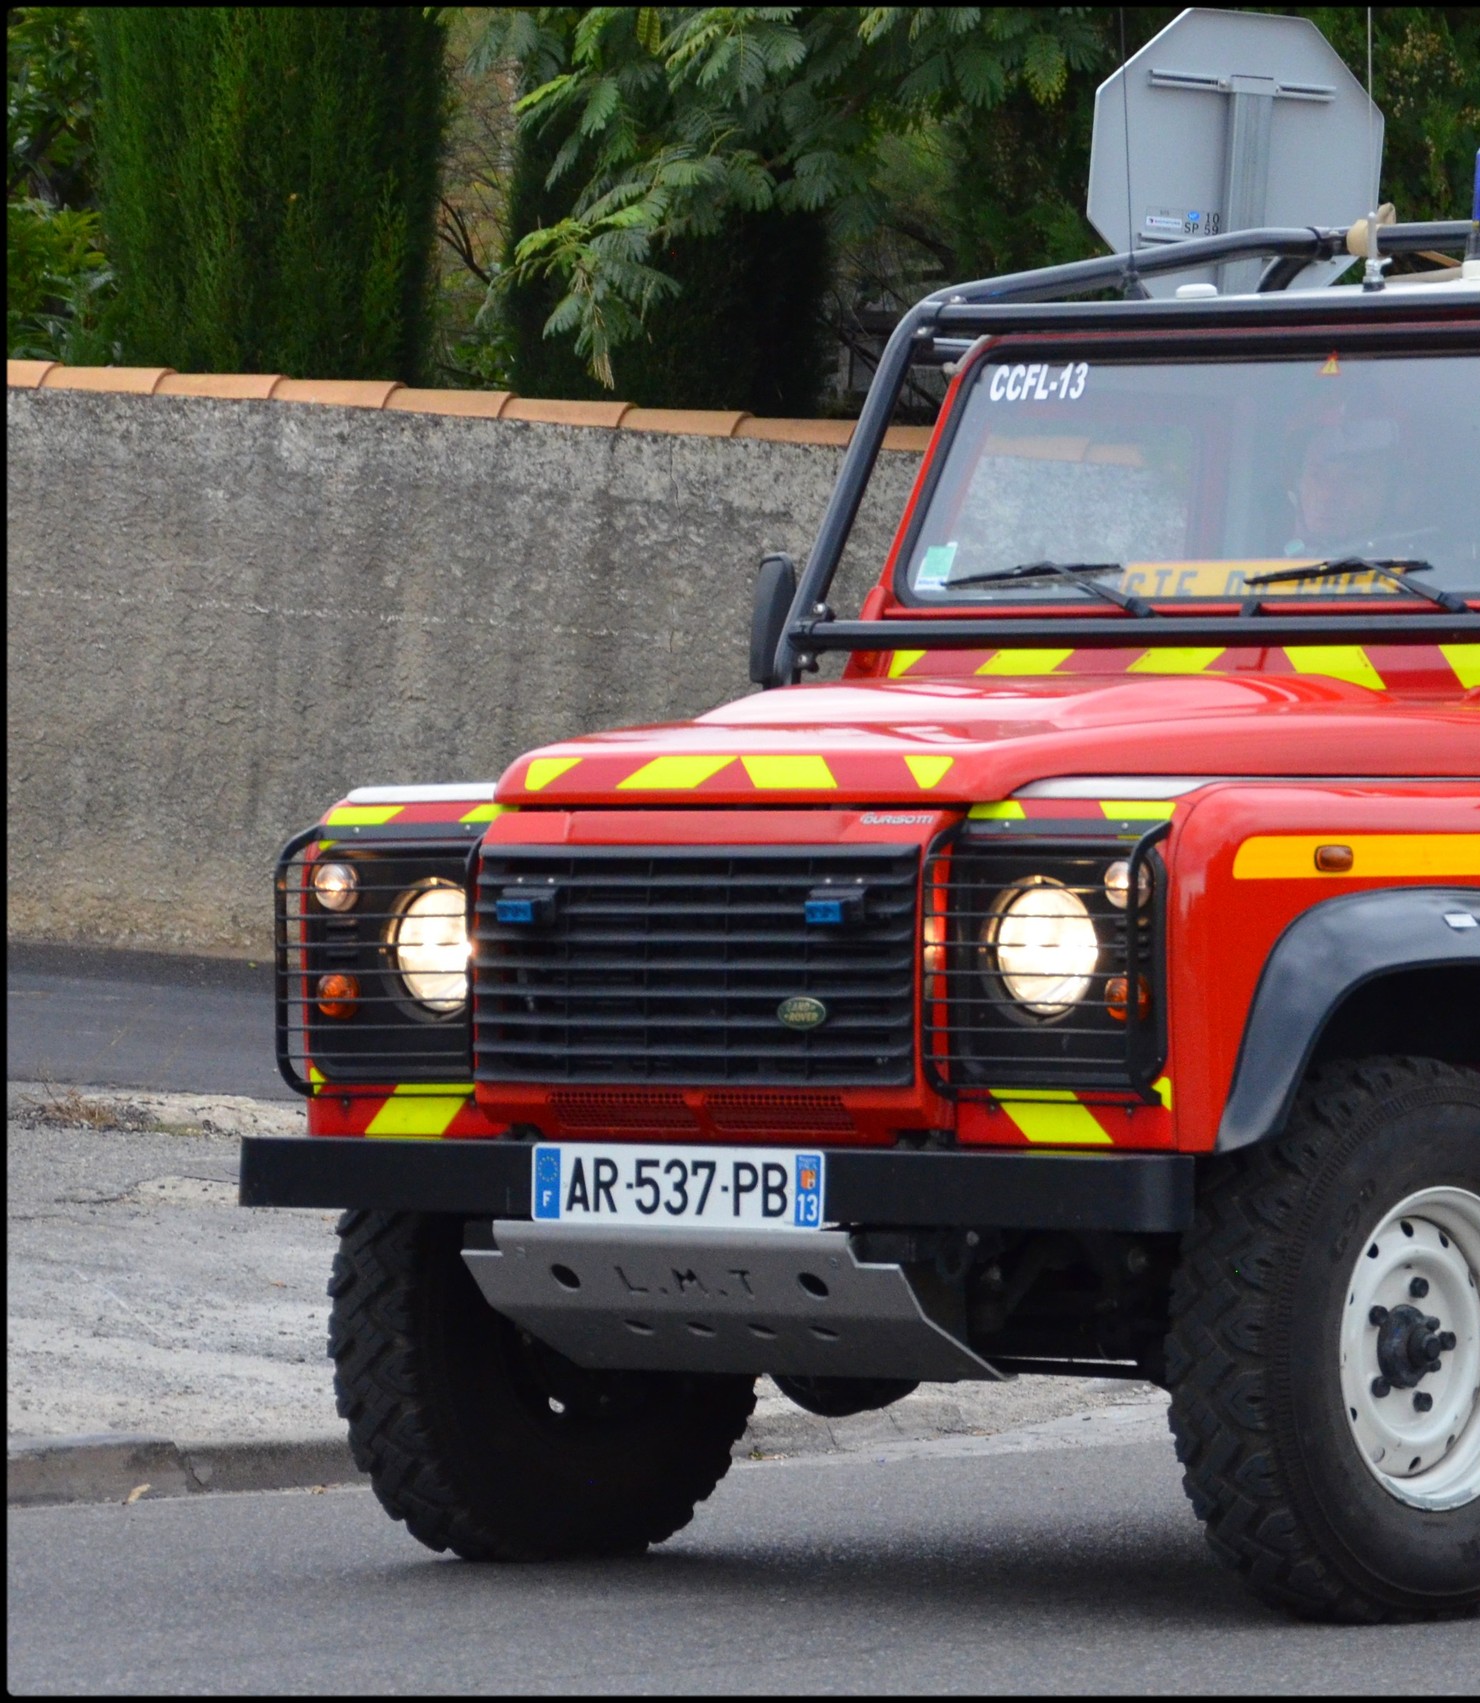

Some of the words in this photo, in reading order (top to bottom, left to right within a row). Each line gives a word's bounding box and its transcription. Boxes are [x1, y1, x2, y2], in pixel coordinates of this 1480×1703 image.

[1184, 222, 1199, 234] SP
[1204, 224, 1219, 236] 59
[1206, 212, 1220, 224] 10
[990, 362, 1089, 401] CCFL-13
[542, 1190, 552, 1207] F
[566, 1157, 788, 1218] AR-537-PB
[797, 1193, 818, 1222] 13
